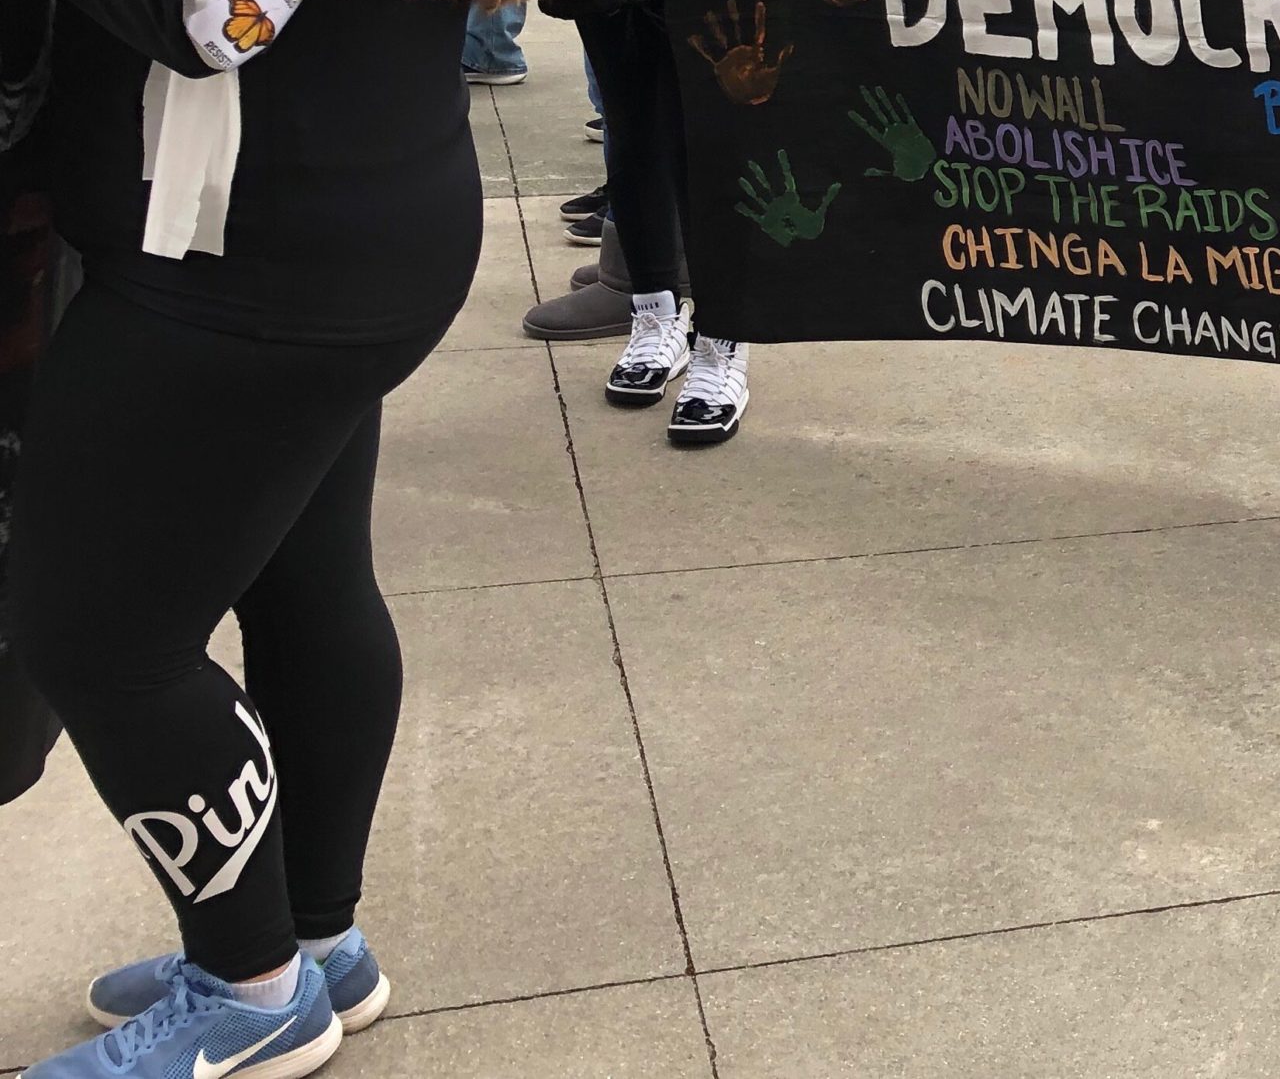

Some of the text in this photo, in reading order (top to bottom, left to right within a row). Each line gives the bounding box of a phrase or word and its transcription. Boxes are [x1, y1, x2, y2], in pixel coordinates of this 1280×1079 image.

[1016, 73, 1126, 133] WALL
[944, 115, 1199, 186] ABOLISH ICE
[933, 159, 1279, 242] STOP THE RAIDS
[942, 223, 1128, 277] CHINGA
[1138, 240, 1193, 284] LA
[921, 279, 1121, 343] CLIMATE
